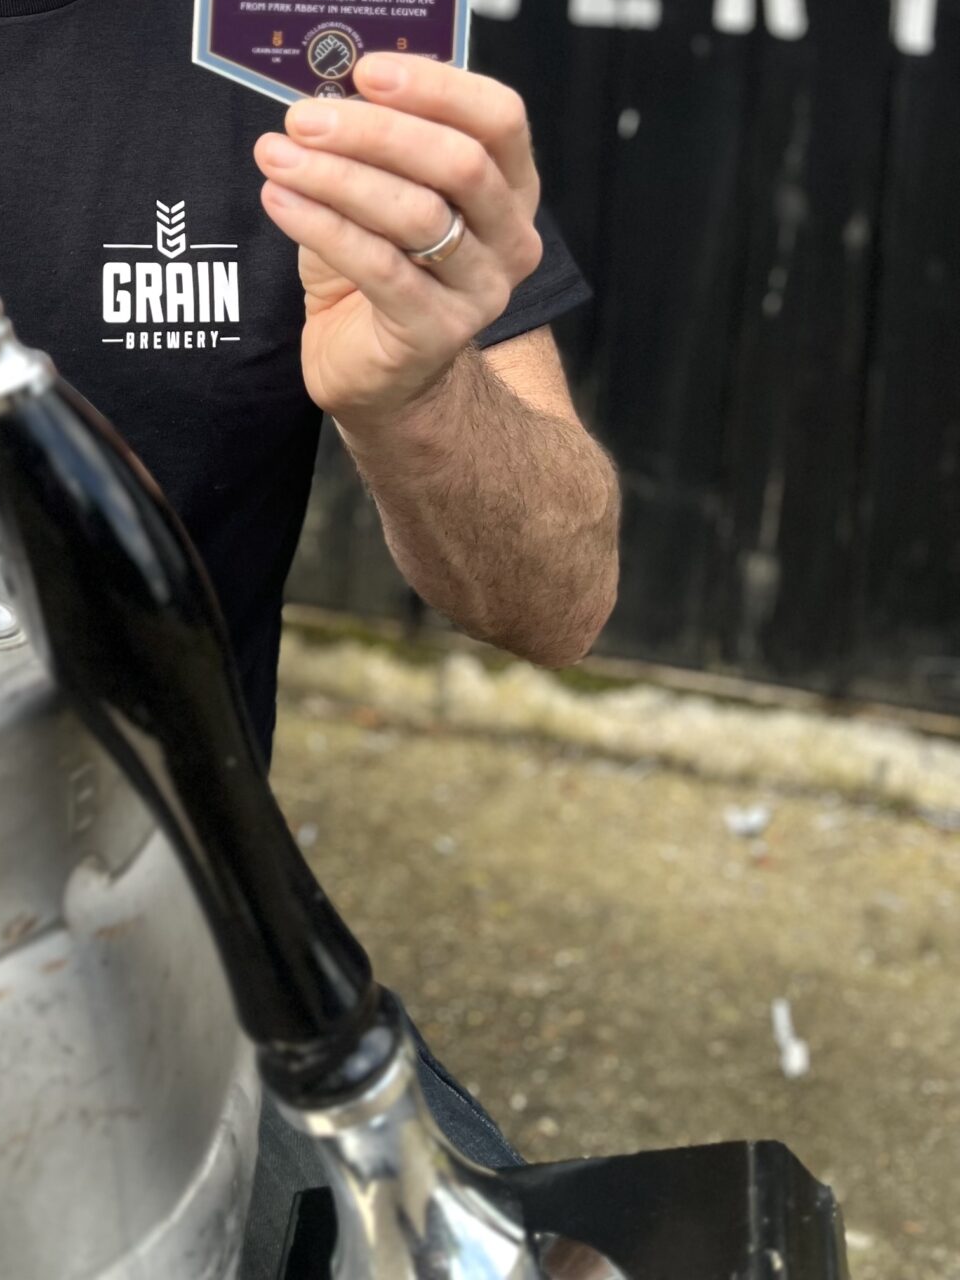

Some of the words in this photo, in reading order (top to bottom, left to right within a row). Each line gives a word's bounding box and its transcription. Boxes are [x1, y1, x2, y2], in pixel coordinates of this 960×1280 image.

[240, 1, 266, 11] FROM
[267, 2, 292, 12] PARK
[294, 3, 325, 13] ABBEY
[327, 5, 339, 14] IN
[391, 7, 428, 17] LEUVEN
[103, 261, 240, 323] GRAIN
[126, 331, 219, 350] BREWERY
